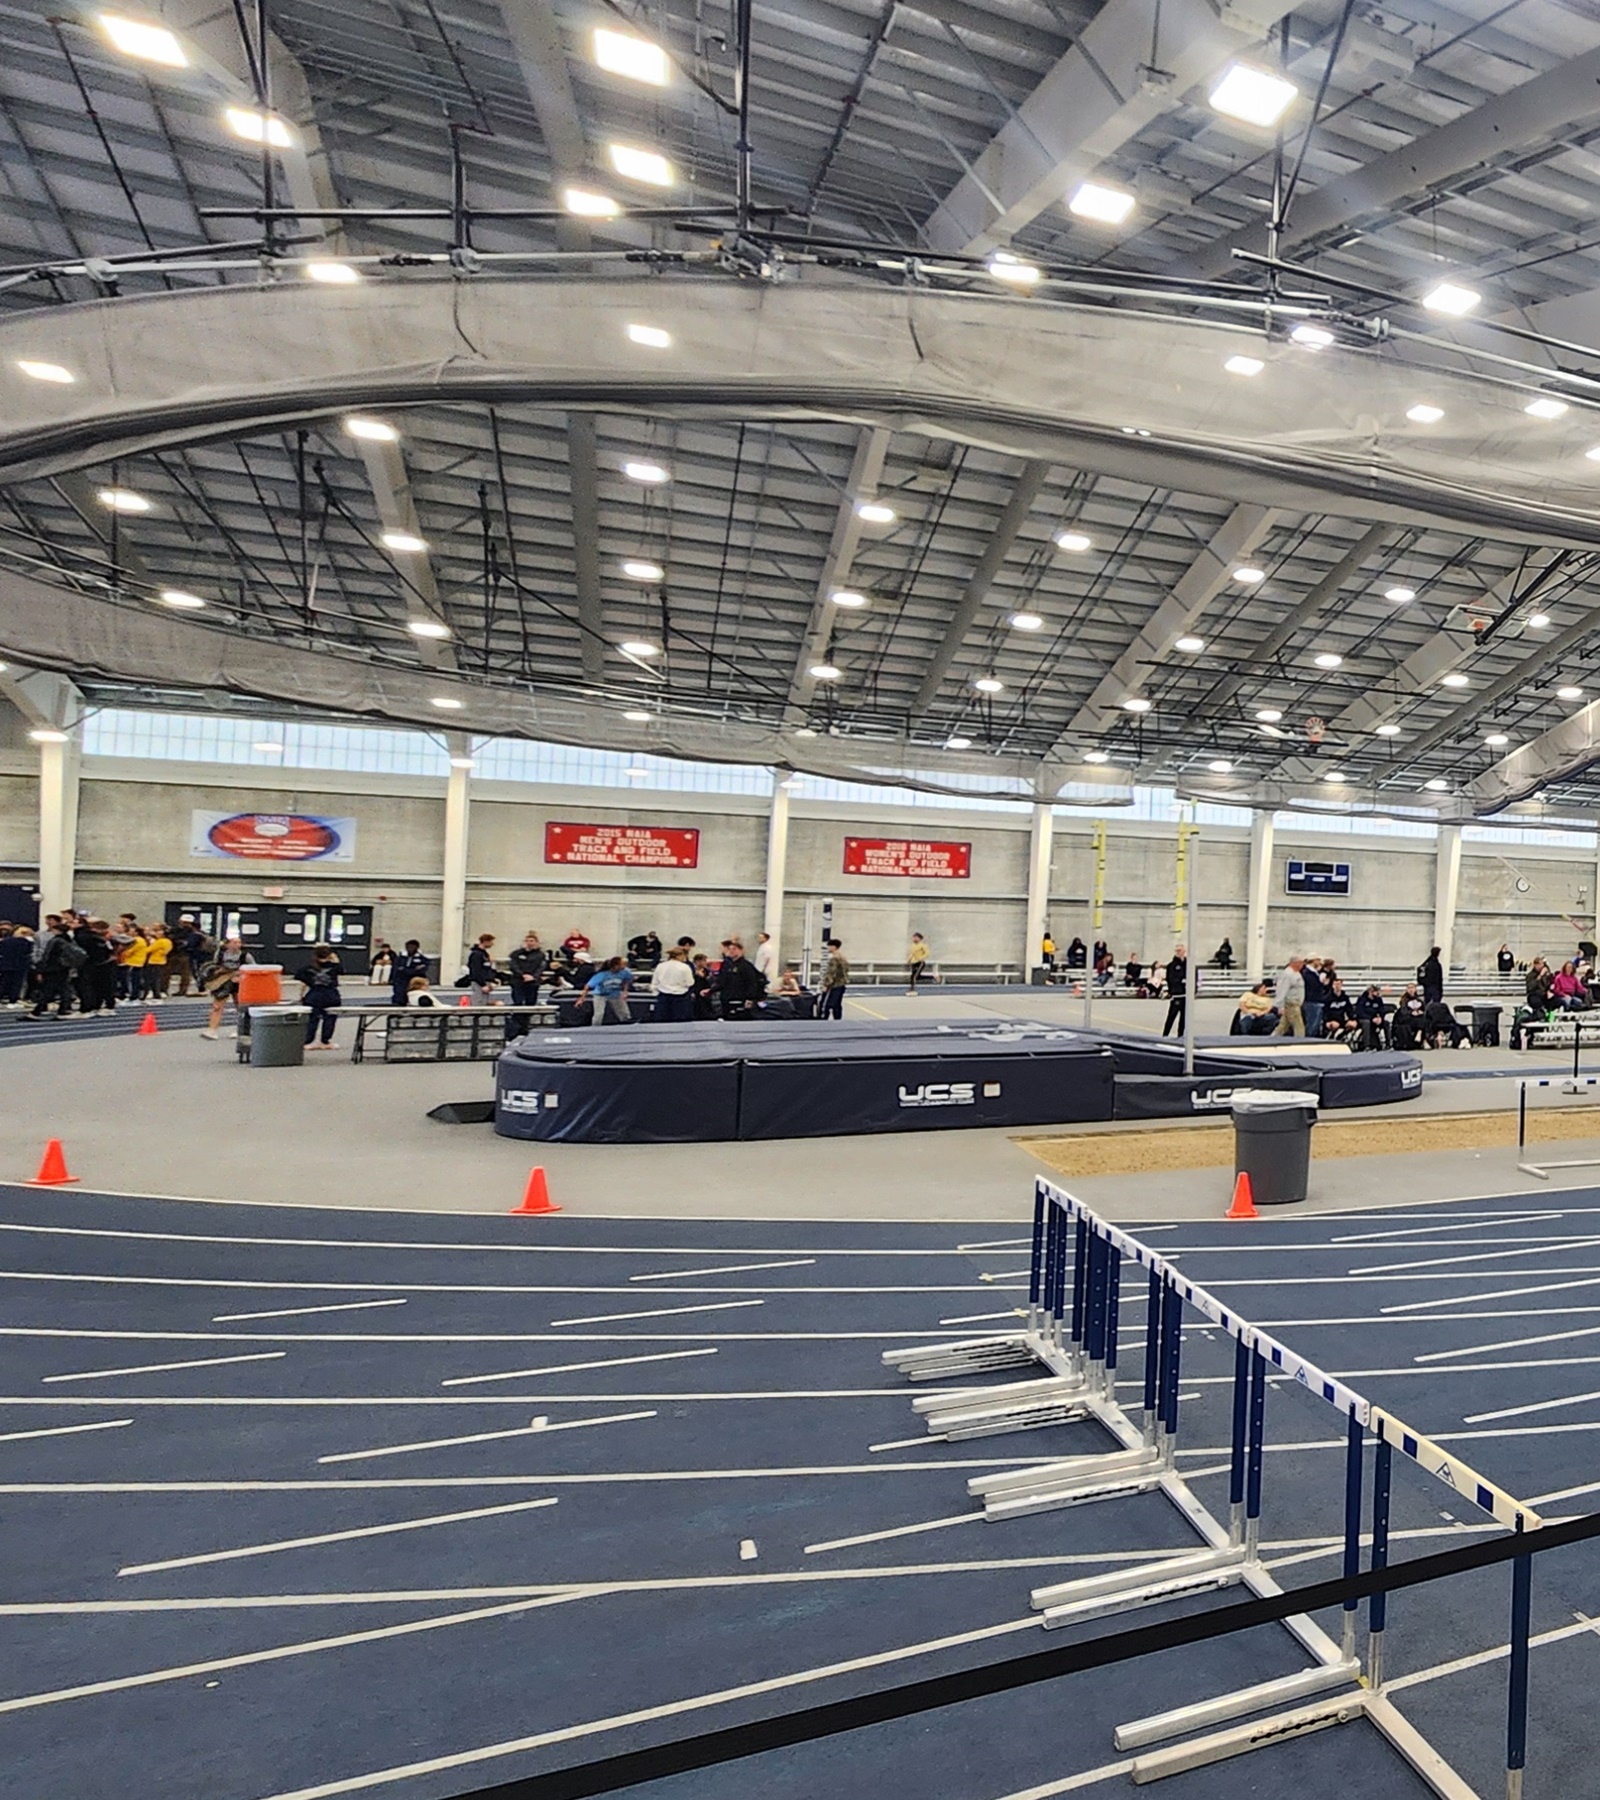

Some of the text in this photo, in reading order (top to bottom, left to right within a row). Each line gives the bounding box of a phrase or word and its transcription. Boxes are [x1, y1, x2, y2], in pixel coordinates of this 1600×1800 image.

[597, 829, 651, 839] 2015 NAIA
[579, 836, 667, 847] MEN'S OUTDOOR
[910, 843, 931, 852] NAIA
[572, 843, 671, 856] TRACK AND FIELD
[865, 849, 950, 861] WOMEN'S OUTDOOR
[566, 852, 678, 865] NATIONAL CHAMPION
[866, 857, 948, 868] TRACK AND FIELD
[860, 864, 953, 876] NATIONAL CHAMPION
[899, 1083, 976, 1100] UCS
[501, 1089, 540, 1107] UCS
